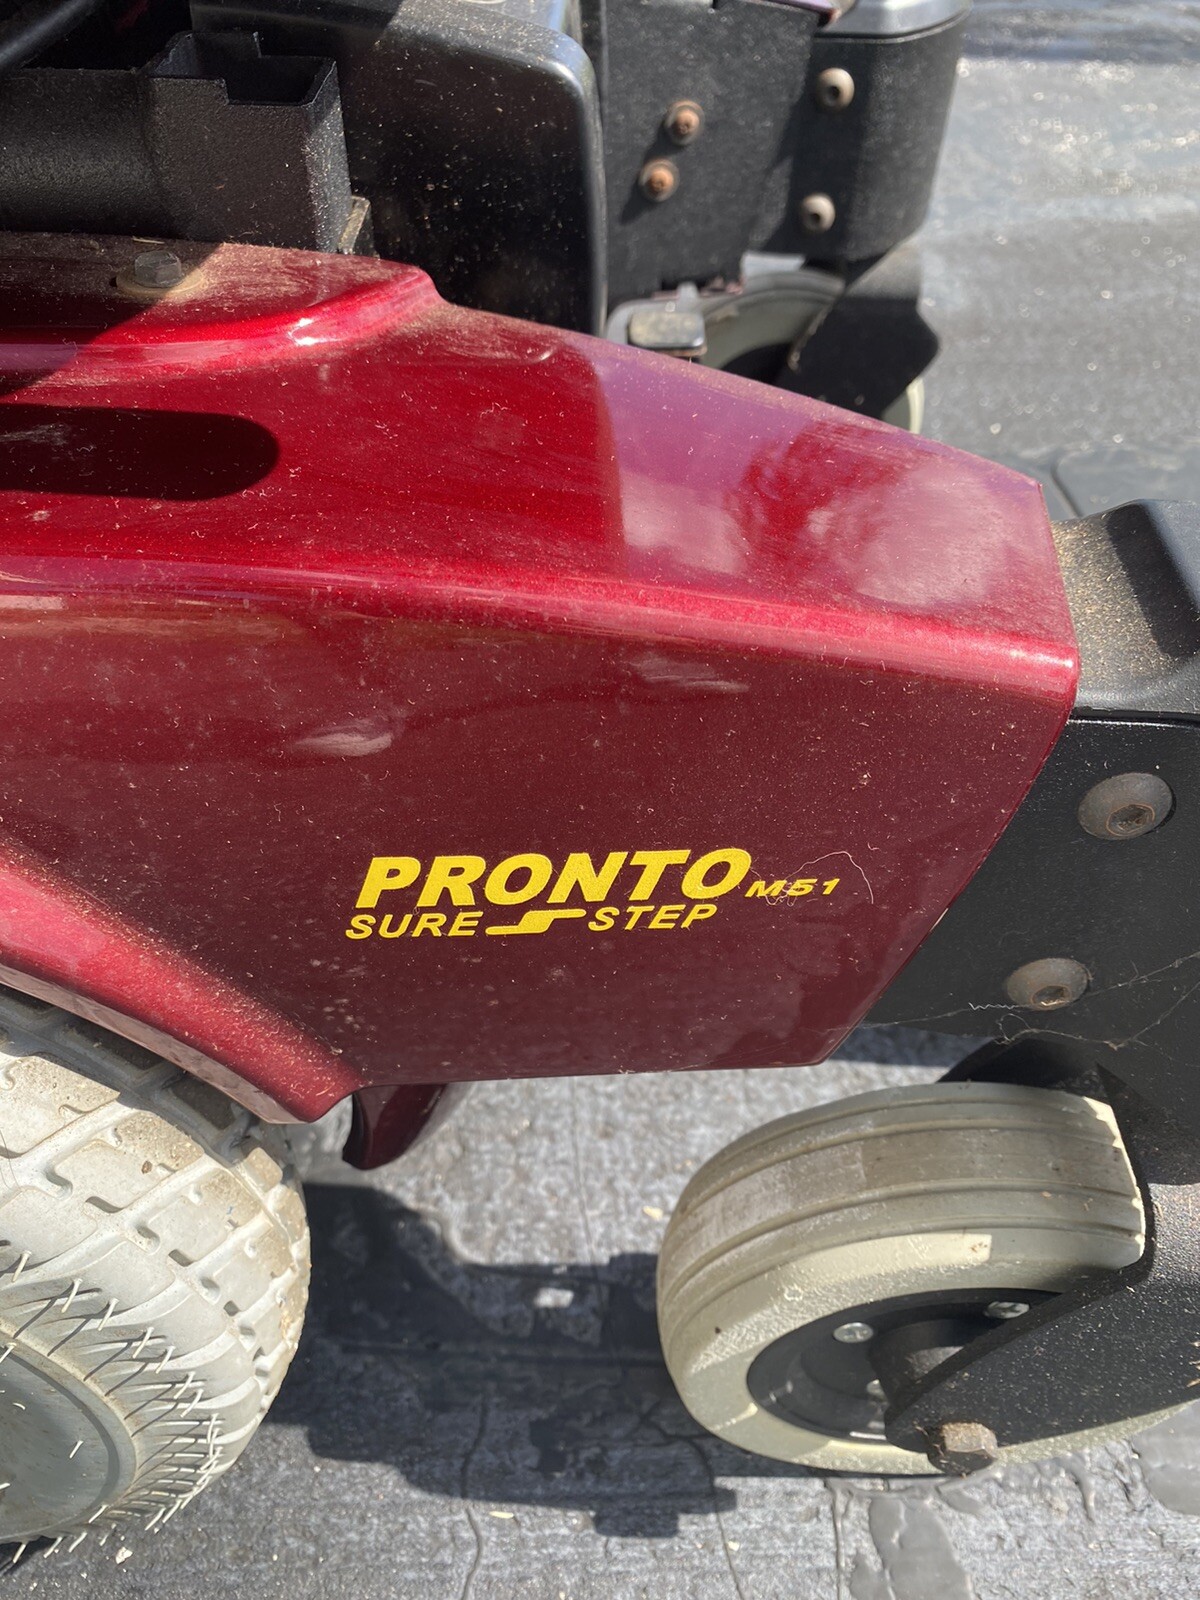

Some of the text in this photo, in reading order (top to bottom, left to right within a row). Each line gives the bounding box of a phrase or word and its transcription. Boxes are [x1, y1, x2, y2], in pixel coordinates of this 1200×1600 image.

[354, 847, 840, 909] PRONTO M51
[344, 903, 718, 940] SURE STEP
